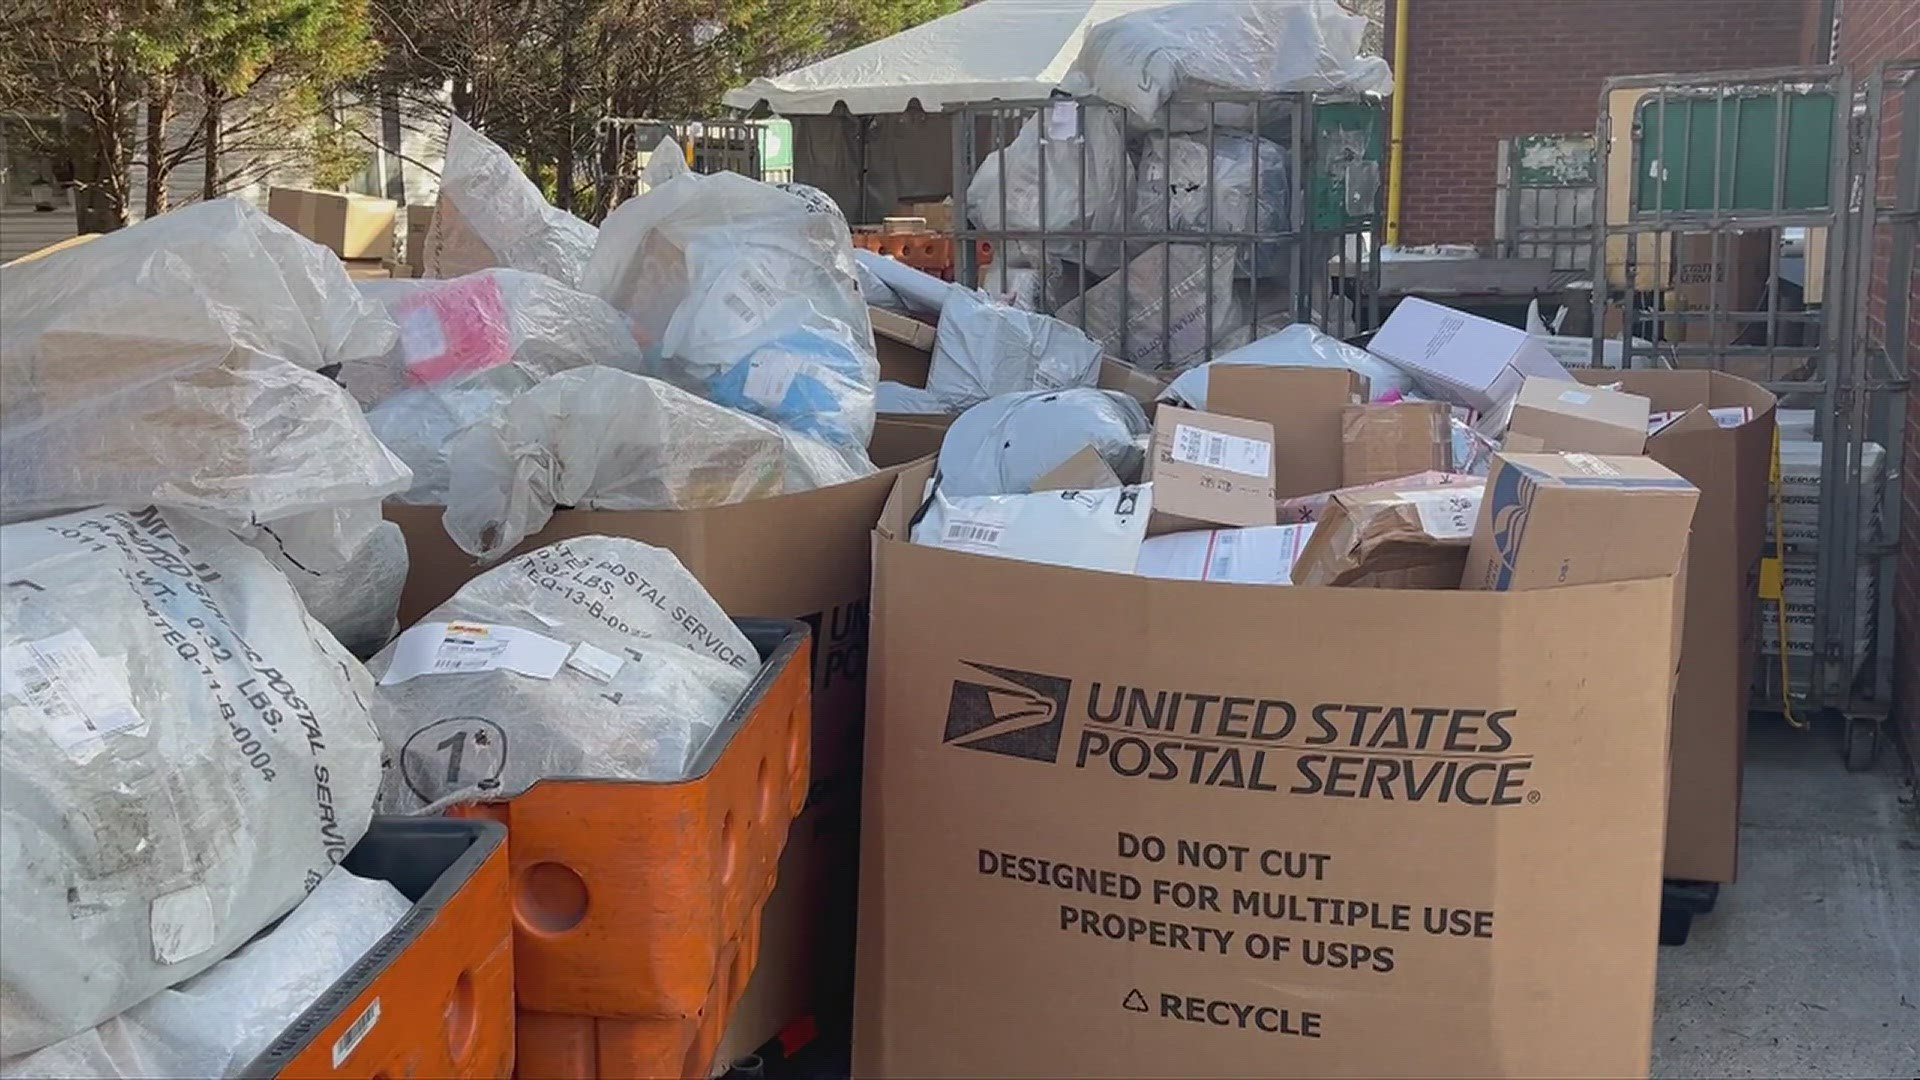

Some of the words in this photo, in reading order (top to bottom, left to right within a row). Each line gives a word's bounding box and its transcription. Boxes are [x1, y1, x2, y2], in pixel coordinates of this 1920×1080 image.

[572, 571, 616, 600] LBS.
[596, 560, 667, 611] POSTAL
[671, 605, 748, 669] SERVICE
[187, 616, 233, 665] 0.32
[237, 678, 284, 734] LBS.
[1088, 682, 1297, 740] UNITED
[1305, 703, 1518, 753] STATES
[1076, 730, 1277, 791] POSTAL
[313, 763, 348, 866] SERVIC
[1118, 831, 1166, 862] DO
[1178, 839, 1250, 873] NOT
[1261, 849, 1332, 881] CUT
[979, 849, 1142, 901] DESIGNED
[1154, 879, 1222, 913] FOR
[1233, 889, 1412, 932] MULTIPLE
[1424, 906, 1494, 939] USE
[1061, 905, 1235, 955] PROPERTY
[1246, 933, 1291, 962] OF
[1303, 939, 1394, 973] USPS
[1161, 992, 1322, 1039] RECYCLE
